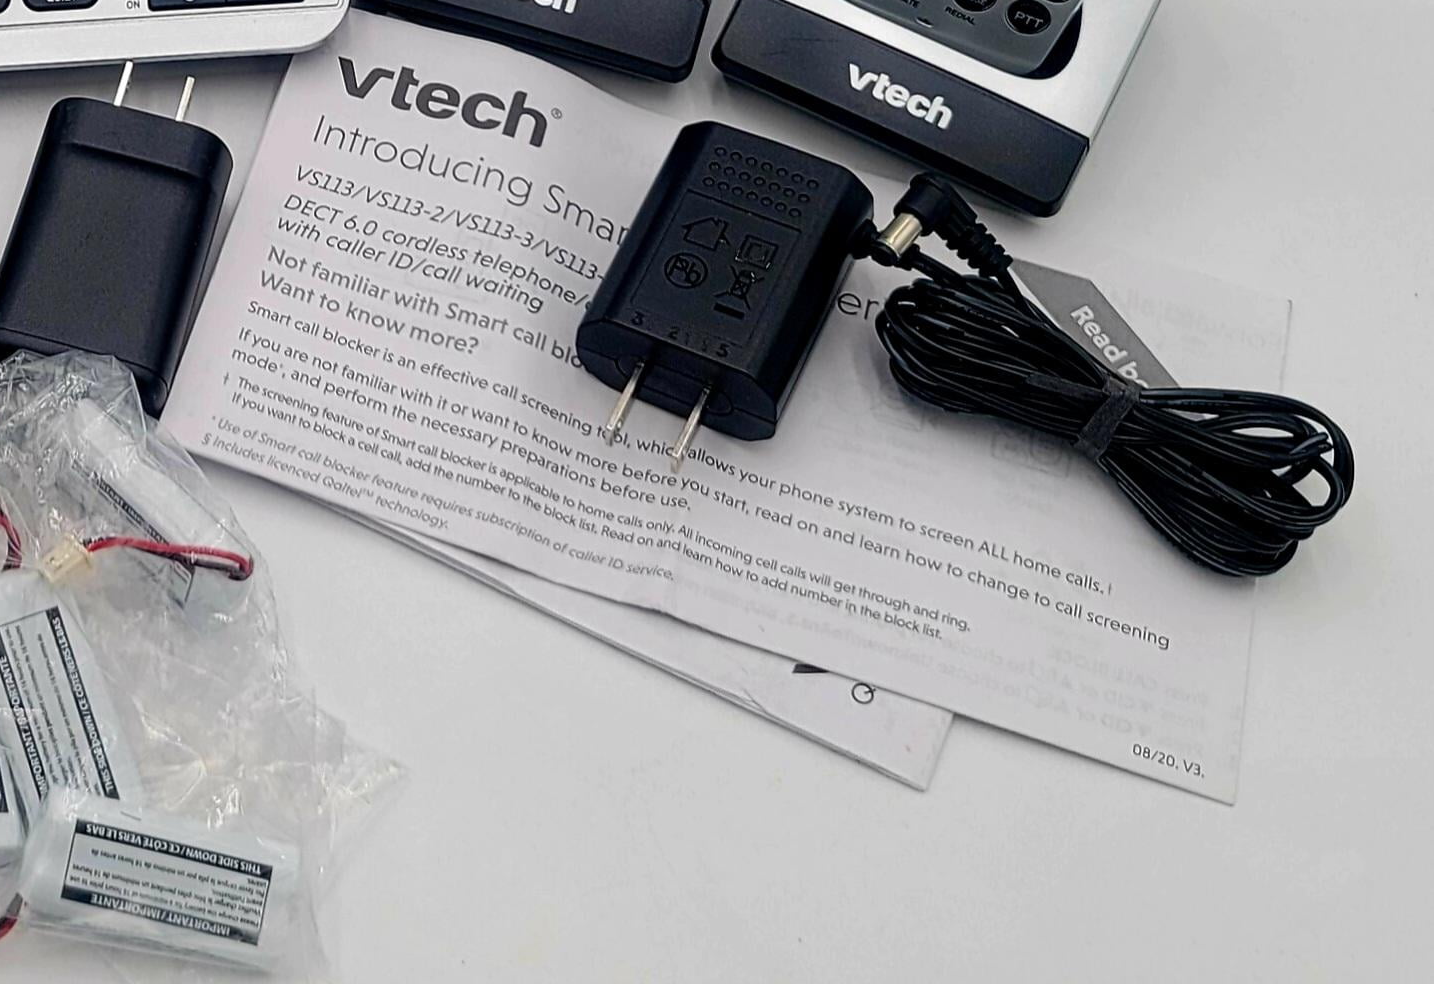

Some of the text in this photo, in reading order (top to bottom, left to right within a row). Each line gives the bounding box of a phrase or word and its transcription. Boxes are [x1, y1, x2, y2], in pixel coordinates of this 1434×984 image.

[126, 0, 140, 9] ON
[847, 62, 953, 129] vtech
[313, 114, 631, 246] Introducing Smar
[284, 194, 343, 225] DECT
[343, 216, 378, 236] 6.0
[382, 229, 468, 261] cordless
[297, 165, 604, 281] VS113/VS113-2/VS113-3/VS113-
[268, 246, 585, 368] Not familiar with Smart call blo
[278, 217, 544, 314] with caller ID/call waiting
[260, 270, 479, 354] Want to know more?
[1070, 306, 1128, 363] Read
[247, 300, 292, 327] Smart
[294, 319, 319, 337] call
[322, 327, 380, 359] blocker
[382, 348, 394, 363] is
[397, 355, 416, 370] an
[420, 363, 489, 390] effective
[492, 381, 517, 400] call
[520, 393, 592, 437] screening
[637, 439, 687, 458] whic
[688, 448, 735, 476] allows
[739, 469, 776, 489] your
[779, 483, 834, 508] phone
[838, 499, 894, 526] system
[899, 518, 915, 532] to
[920, 525, 974, 550] screen
[978, 540, 1009, 561] ALL
[1013, 550, 1061, 578] home
[1066, 572, 1104, 595] calls.
[291, 368, 691, 513] and perform the necessary preparations before use.
[238, 327, 1171, 651] If you are not familiar with it or want to know more before you start, read on and learn how to change to call screening
[1132, 744, 1179, 771] 08/20.
[217, 854, 240, 869] SIDE
[240, 860, 262, 875] THIS
